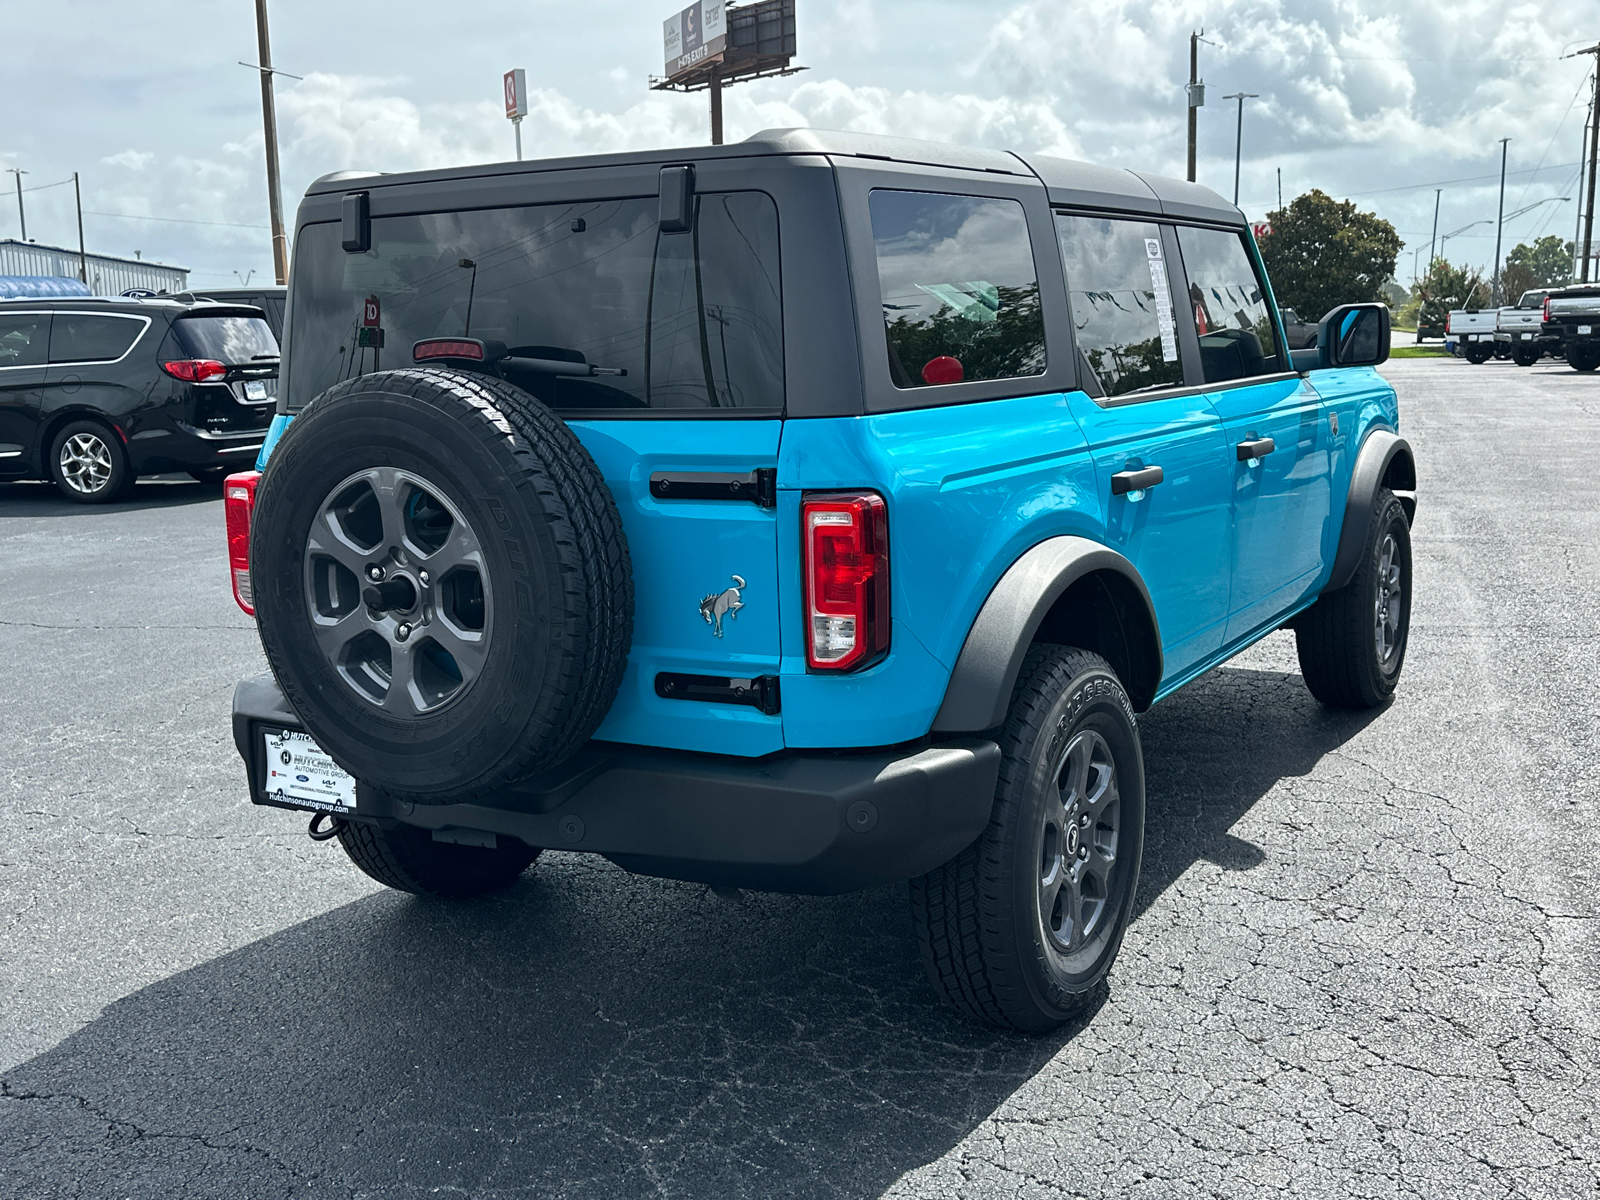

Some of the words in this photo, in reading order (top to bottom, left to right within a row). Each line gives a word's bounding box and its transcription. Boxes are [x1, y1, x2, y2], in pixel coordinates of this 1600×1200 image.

[677, 53, 691, 69] I-475
[691, 46, 704, 62] EXIT
[703, 44, 708, 56] 9
[1254, 224, 1268, 237] K
[481, 495, 534, 724] DUELER
[294, 765, 330, 777] AUTOMOTIVE
[330, 771, 350, 780] GROUP
[269, 793, 349, 813] Hutchinsonautogroup.com
